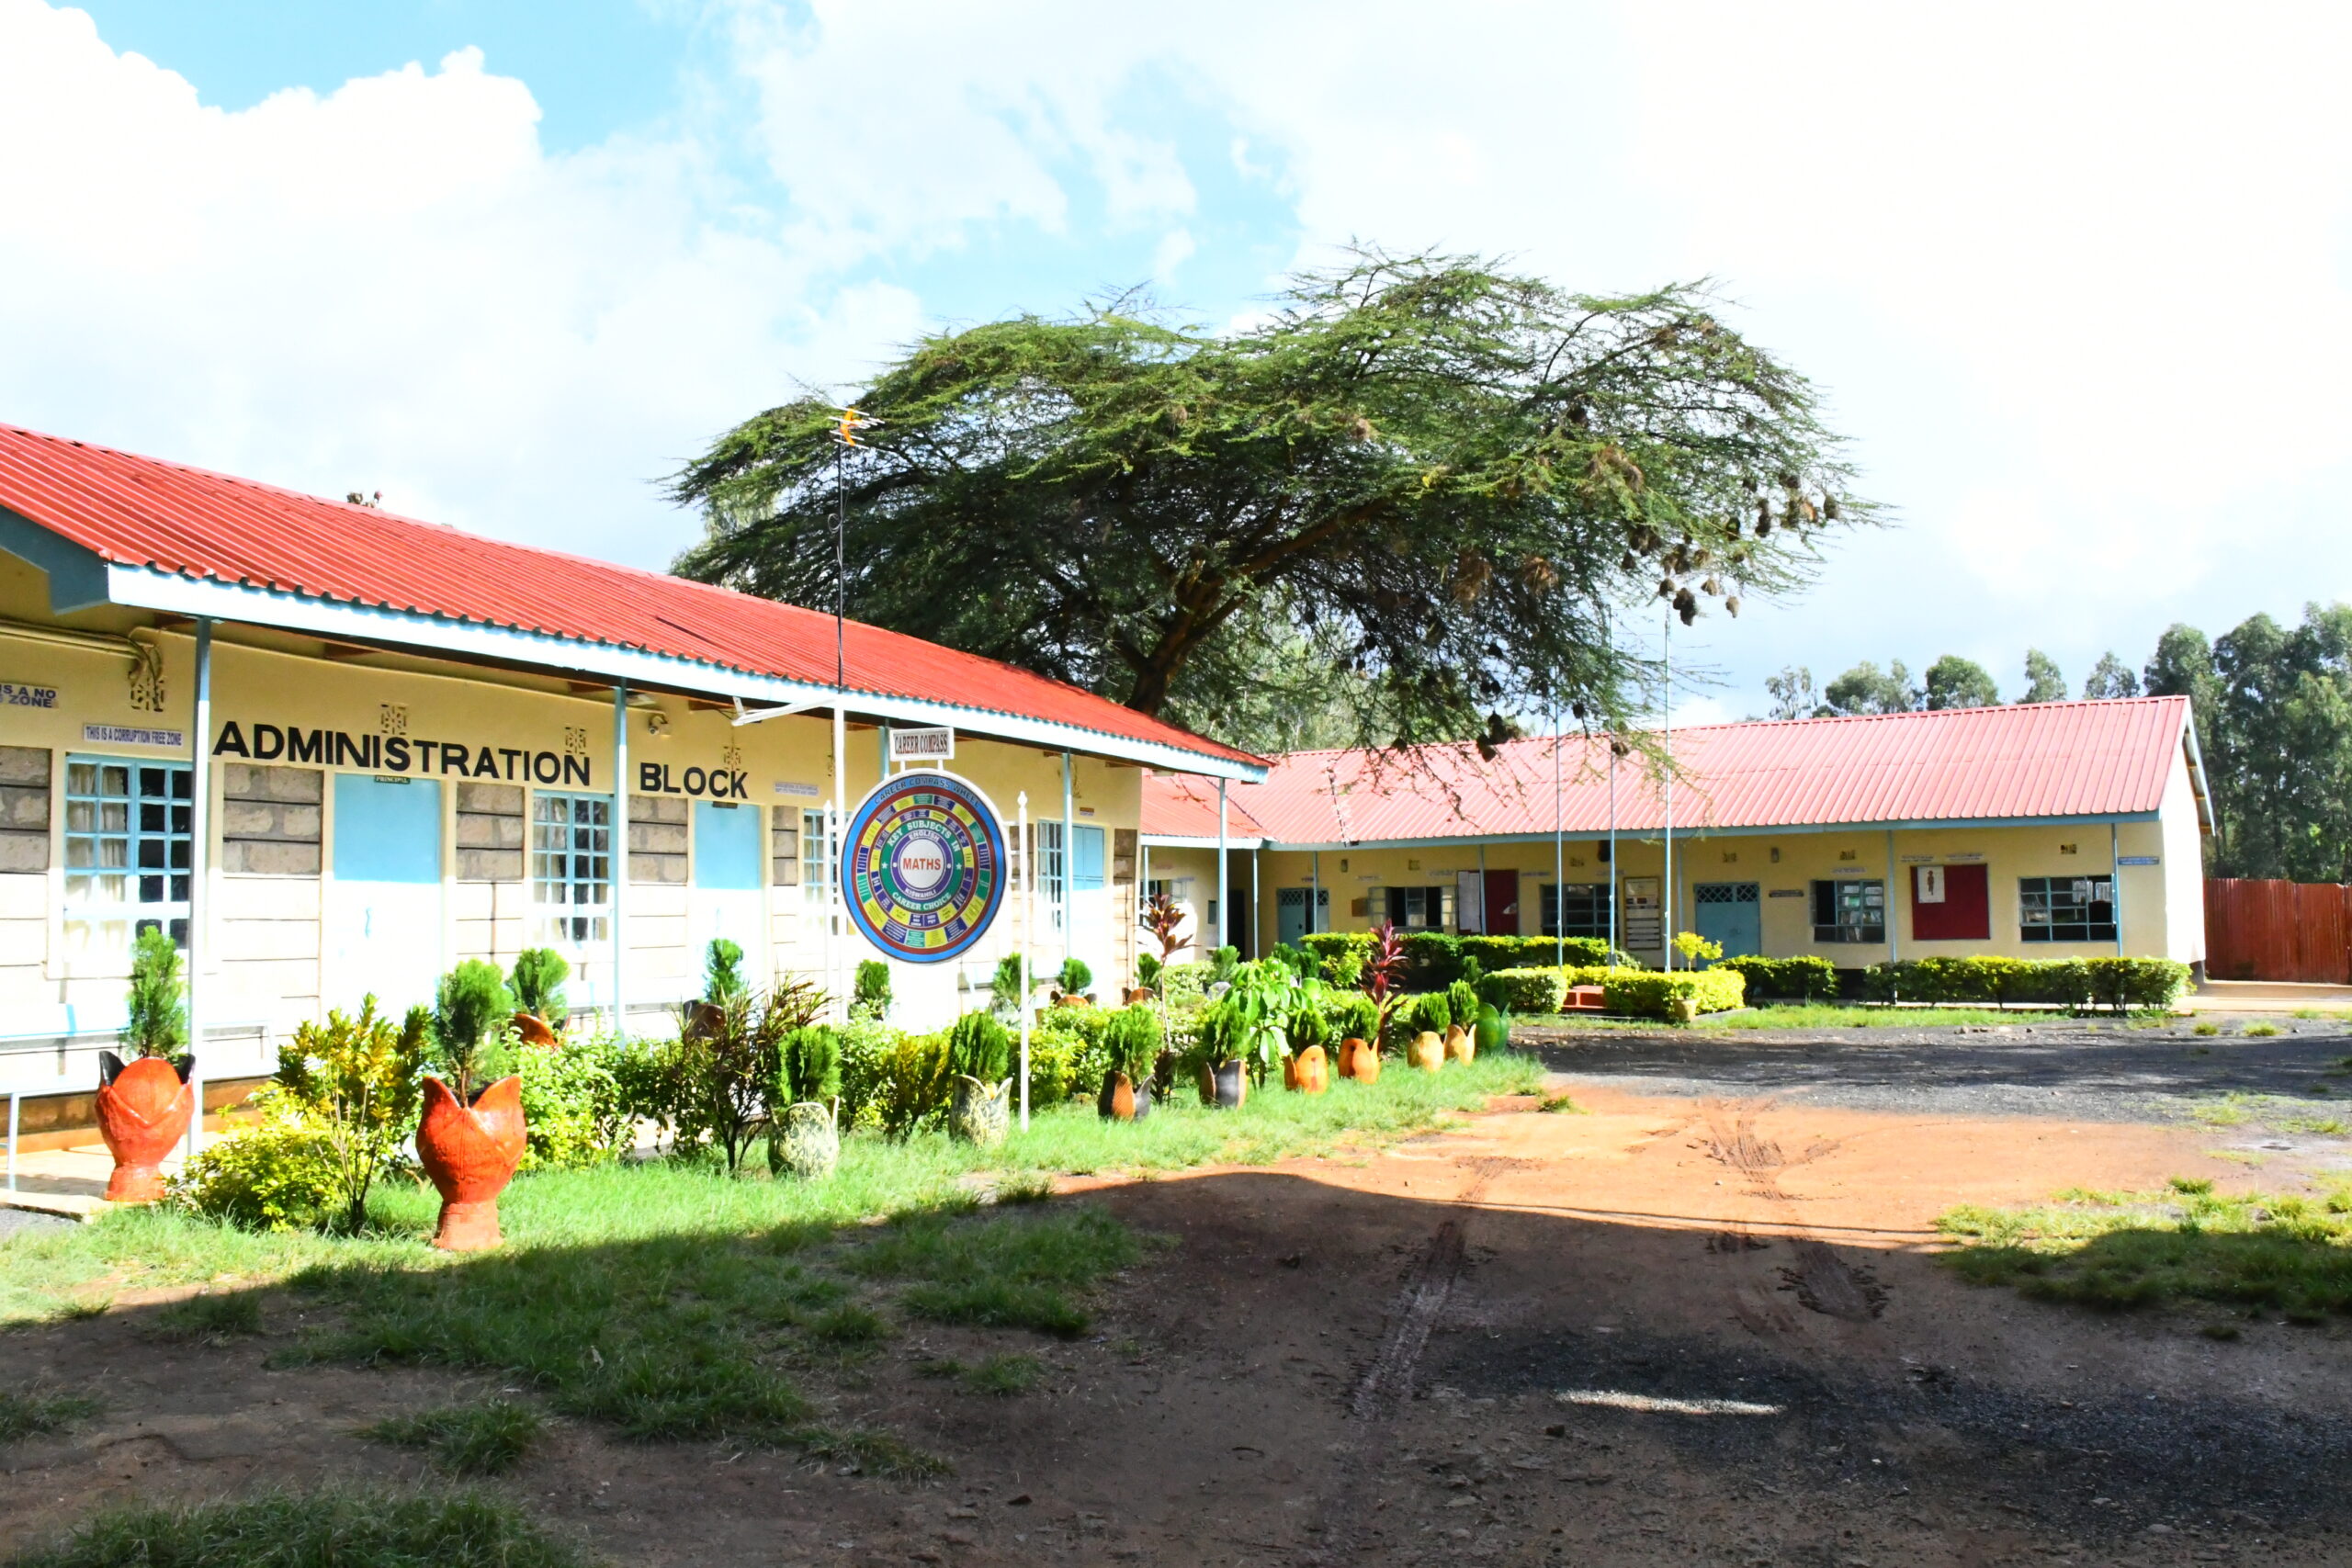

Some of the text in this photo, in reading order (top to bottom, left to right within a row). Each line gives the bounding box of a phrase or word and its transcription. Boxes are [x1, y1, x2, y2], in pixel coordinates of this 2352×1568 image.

[9, 695, 52, 707] ZONE
[19, 687, 28, 695] A
[34, 688, 56, 698] NO
[86, 726, 182, 746] THIS IS A CORRUPTION FREE ZONE
[895, 734, 947, 754] CAREER COMPASS
[212, 720, 748, 799] ADMINISTRATION BLOCK
[875, 782, 906, 804] CAREER
[910, 778, 950, 788] COMPASS
[953, 785, 979, 808] WHEEL
[887, 820, 961, 852] KEY SUBJECTS IN
[908, 829, 940, 841] ENGLISH
[902, 858, 941, 871] MATHS
[892, 892, 922, 910] CAREER
[922, 892, 952, 910] CHOICE
[905, 889, 936, 898] KISWAHILI
